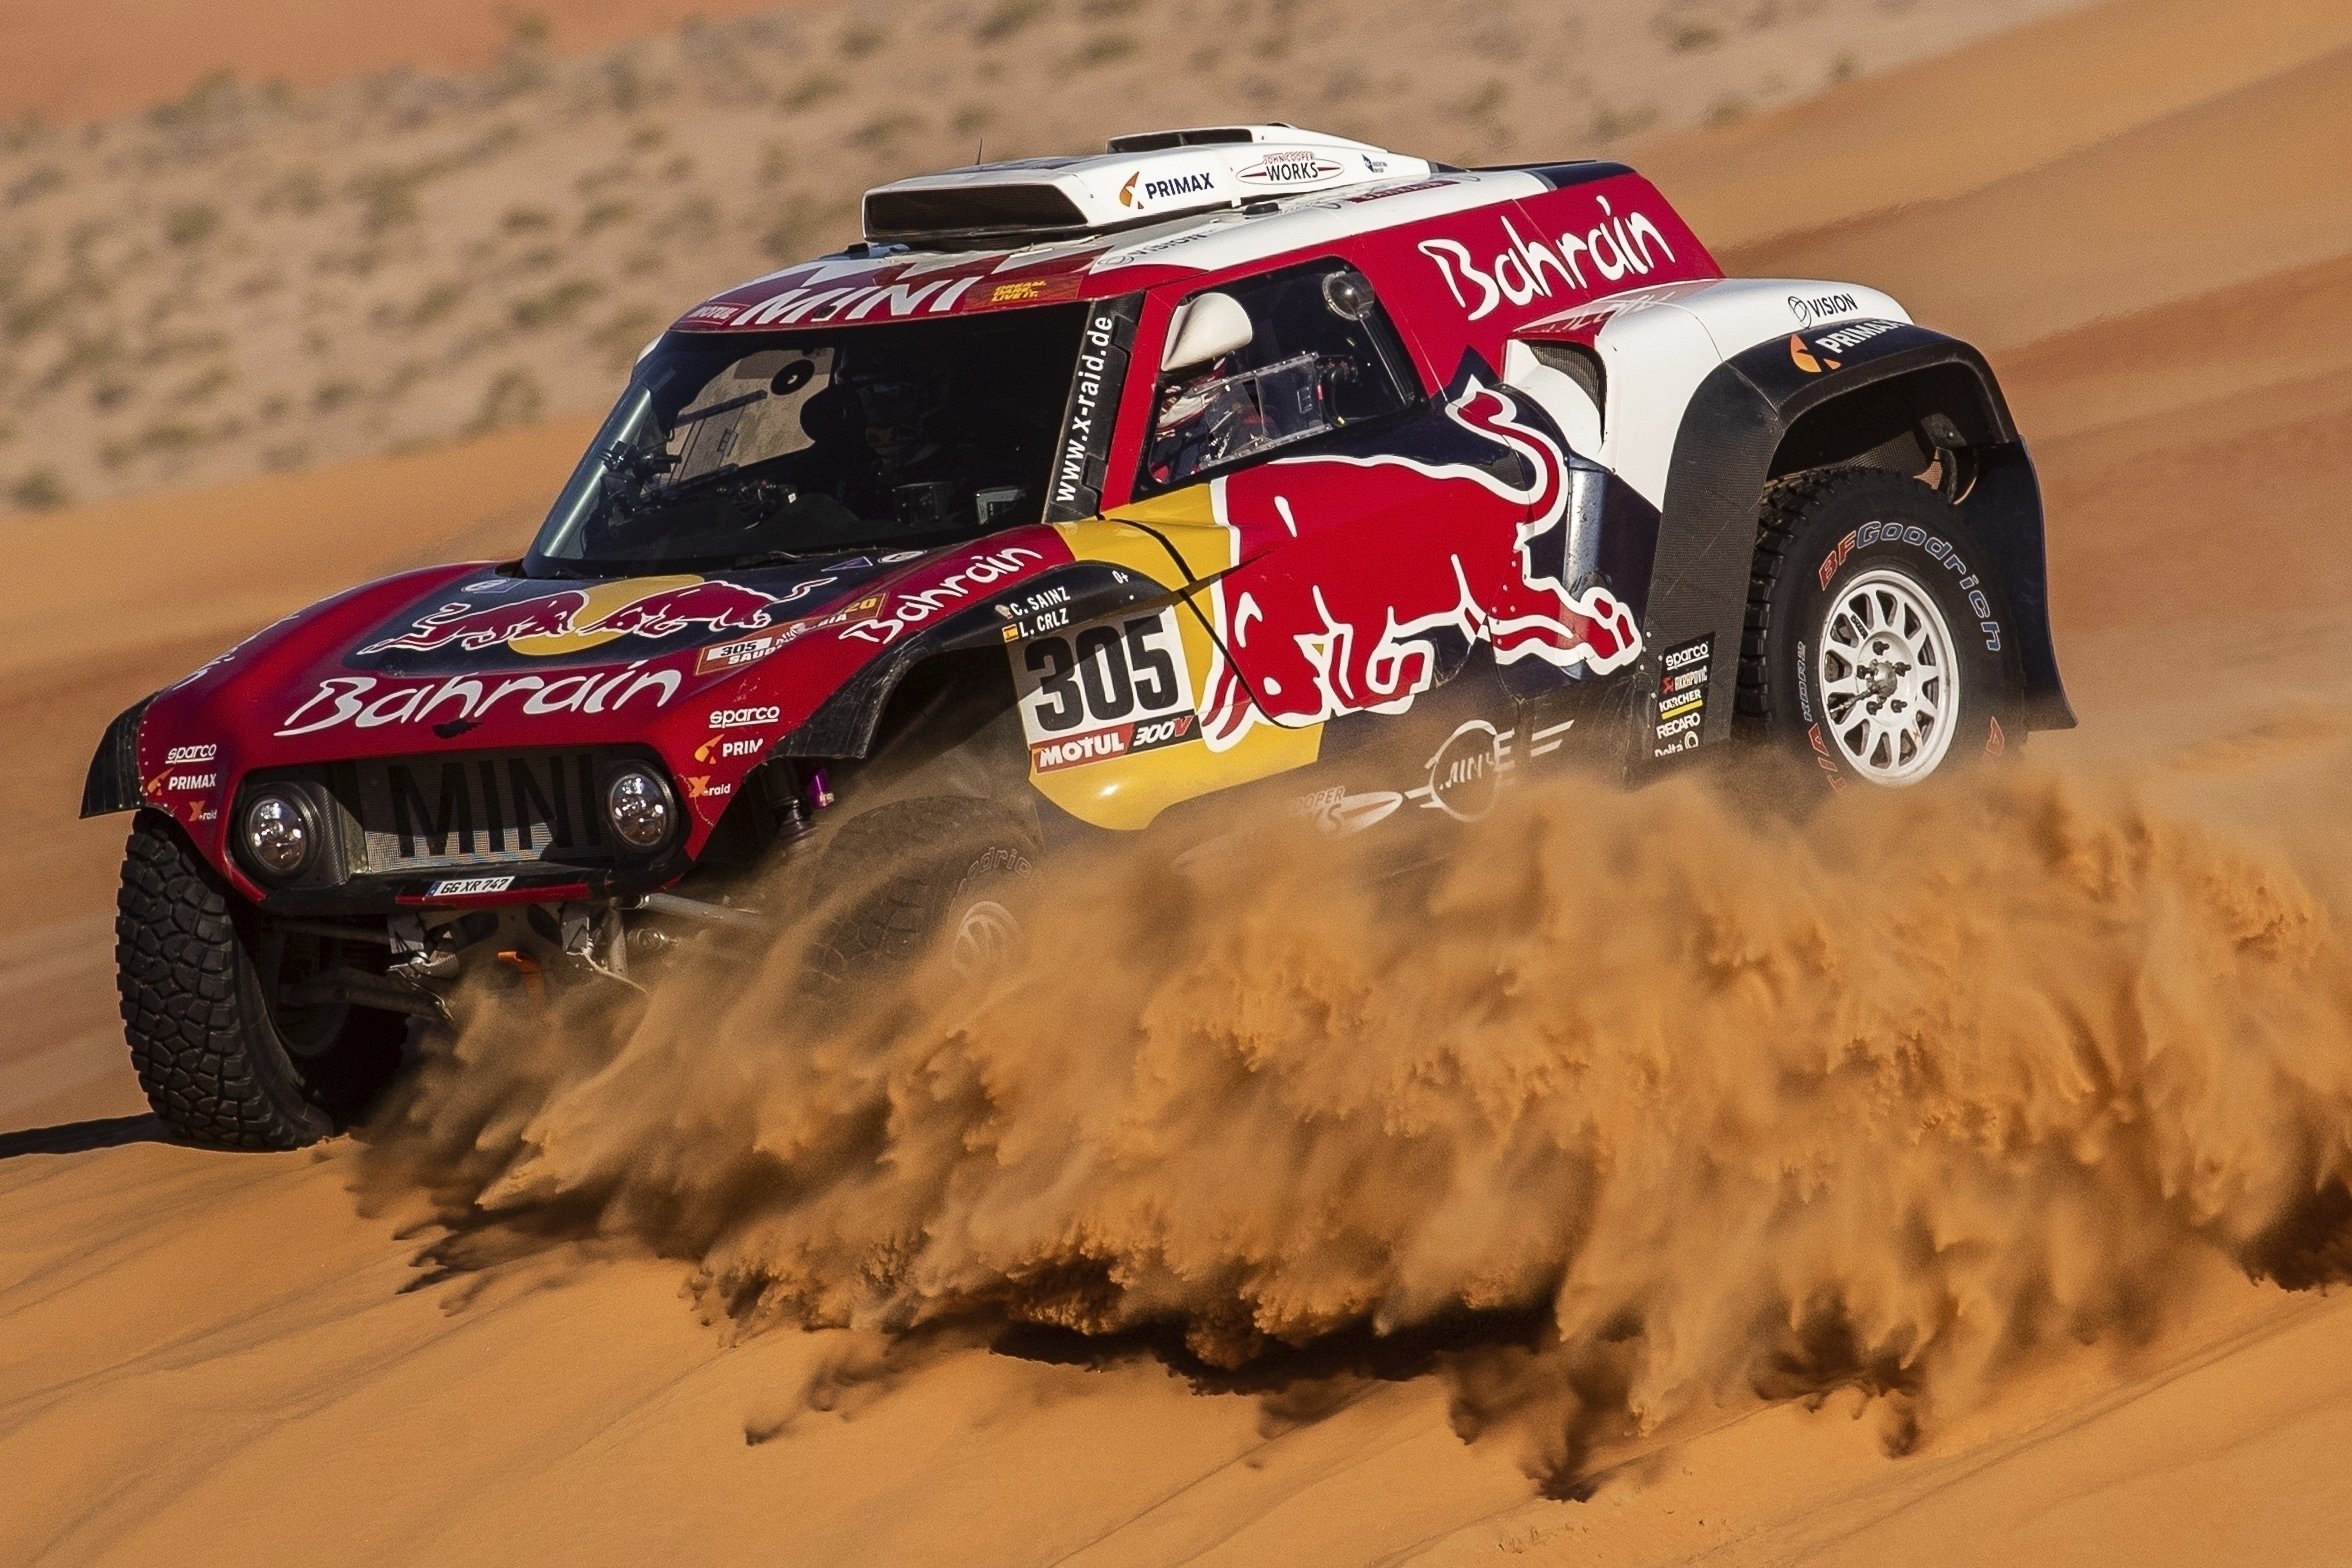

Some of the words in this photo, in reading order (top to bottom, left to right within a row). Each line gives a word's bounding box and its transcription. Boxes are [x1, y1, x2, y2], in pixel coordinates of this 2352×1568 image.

[1145, 172, 1215, 200] PRIMAX
[1266, 162, 1319, 181] WORKS
[1418, 196, 1676, 321] Bahrain
[729, 275, 984, 327] MINI
[1806, 293, 1859, 318] VISION
[1056, 316, 1113, 502] www.x-raid.de
[838, 546, 1043, 645] Bahrain
[1010, 602, 1029, 616] C.
[1027, 585, 1071, 611] SAINZ
[1818, 520, 2001, 652] BFGoodrich
[1018, 621, 1035, 638] L.
[1036, 607, 1069, 632] CRLZ
[720, 641, 758, 657] 305
[1665, 642, 1710, 670] sparco
[1023, 613, 1180, 732] 305
[274, 659, 682, 738] Bahrain
[708, 705, 781, 729] sparco
[1655, 712, 1701, 740] RECARO
[165, 744, 217, 765] sparco
[722, 738, 764, 758] PRIM
[1039, 732, 1125, 768] MOTUL
[1133, 714, 1195, 748] 300V
[168, 773, 217, 791] PRIMAX
[386, 753, 602, 858] MINI
[440, 882, 462, 894] GG
[460, 880, 482, 893] XR
[481, 878, 511, 891] 747
